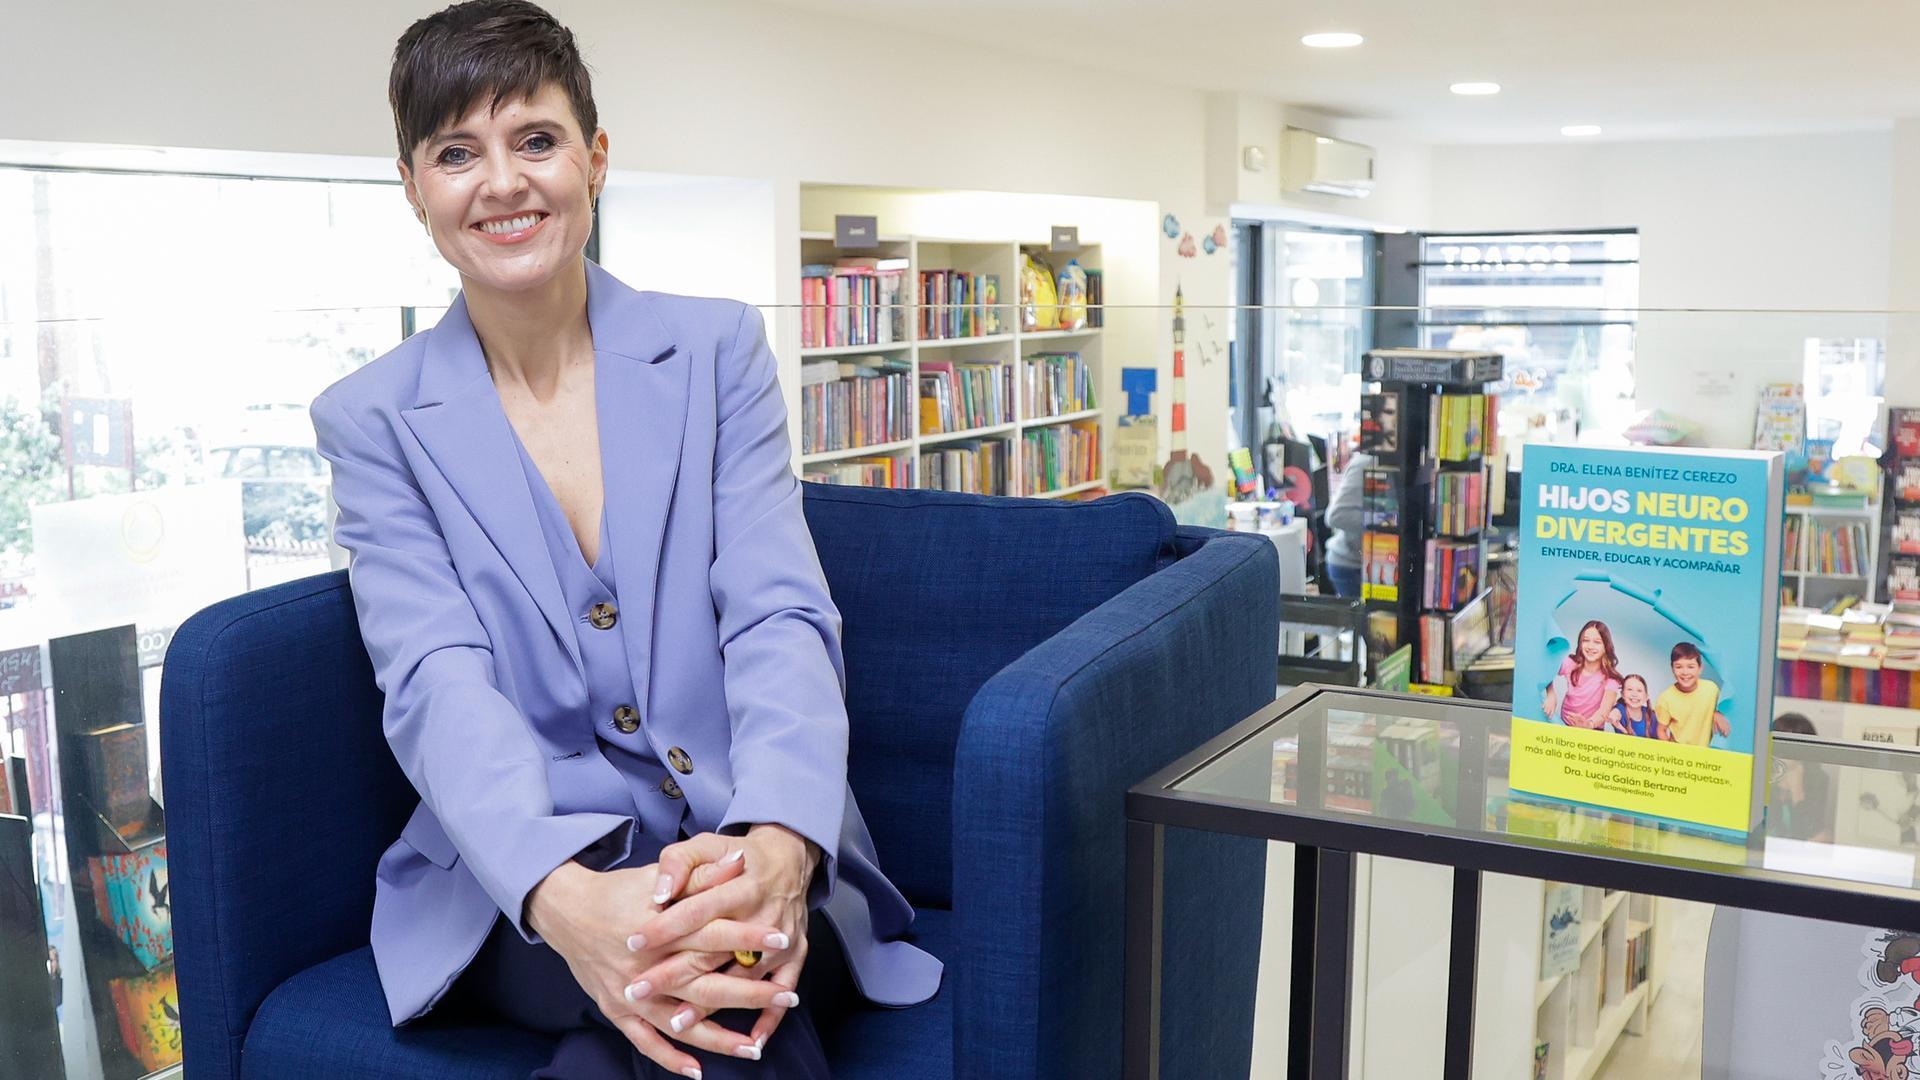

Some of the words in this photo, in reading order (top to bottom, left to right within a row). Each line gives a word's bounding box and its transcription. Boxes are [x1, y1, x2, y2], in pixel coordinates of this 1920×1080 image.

[1550, 462, 1578, 474] DRA.
[1582, 464, 1622, 477] ELENA
[1625, 465, 1679, 481] BENÍTEZ
[1682, 470, 1738, 485] CEREZO
[1538, 484, 1632, 515] HIJOS
[1635, 491, 1749, 523] NEURO
[1536, 515, 1750, 556] DIVERGENTES
[1541, 546, 1602, 562] ENTENDER,
[1604, 552, 1651, 567] EDUCAR
[1653, 557, 1662, 567] Y
[1663, 558, 1742, 575] ACOMPAÑAR
[1525, 744, 1544, 755] más
[1545, 747, 1563, 758] allá
[1564, 750, 1577, 761] de
[1578, 752, 1591, 764] los
[1592, 756, 1652, 773] diagnósticos
[1653, 767, 1660, 776] y
[1661, 766, 1675, 777] las
[1555, 736, 1576, 749] libro
[1577, 741, 1617, 755] especial
[1617, 748, 1636, 759] que
[1638, 752, 1655, 761] nos
[1656, 753, 1684, 766] invita
[1686, 759, 1694, 768] a
[1695, 761, 1723, 772] mirar
[1564, 766, 1584, 777] Dra.
[1585, 769, 1611, 782] Lucía
[1612, 773, 1641, 787] Galán
[1643, 779, 1688, 795] Bertrand
